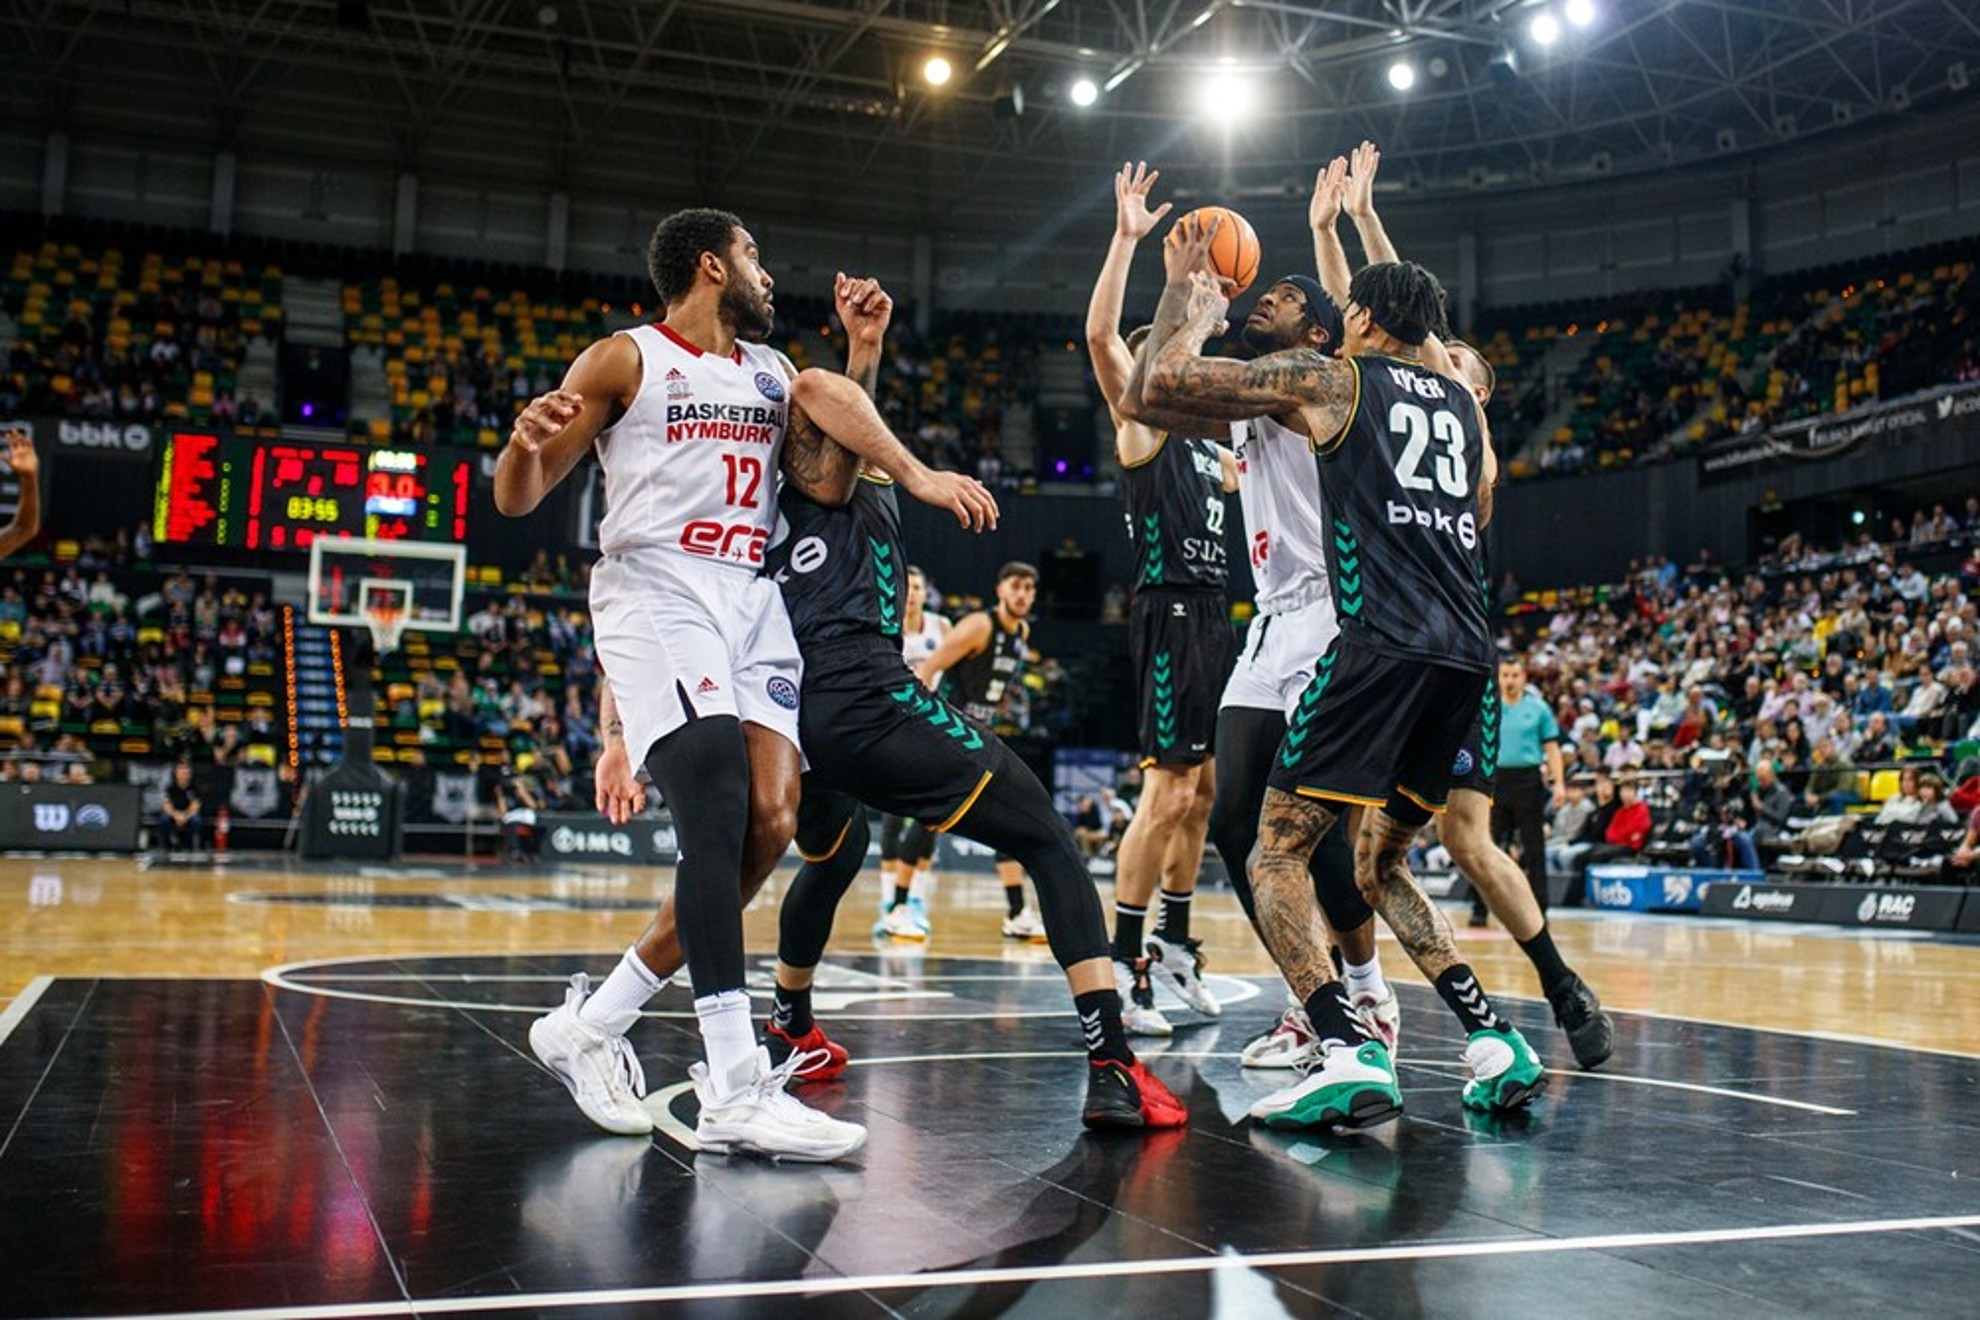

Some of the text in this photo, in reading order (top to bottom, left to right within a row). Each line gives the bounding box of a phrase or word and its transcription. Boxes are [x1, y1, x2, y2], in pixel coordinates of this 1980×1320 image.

[58, 420, 122, 447] bbk
[667, 422, 773, 444] NYMBURK
[1389, 401, 1469, 498] 23
[722, 453, 762, 509] 12
[1386, 500, 1454, 536] bbk
